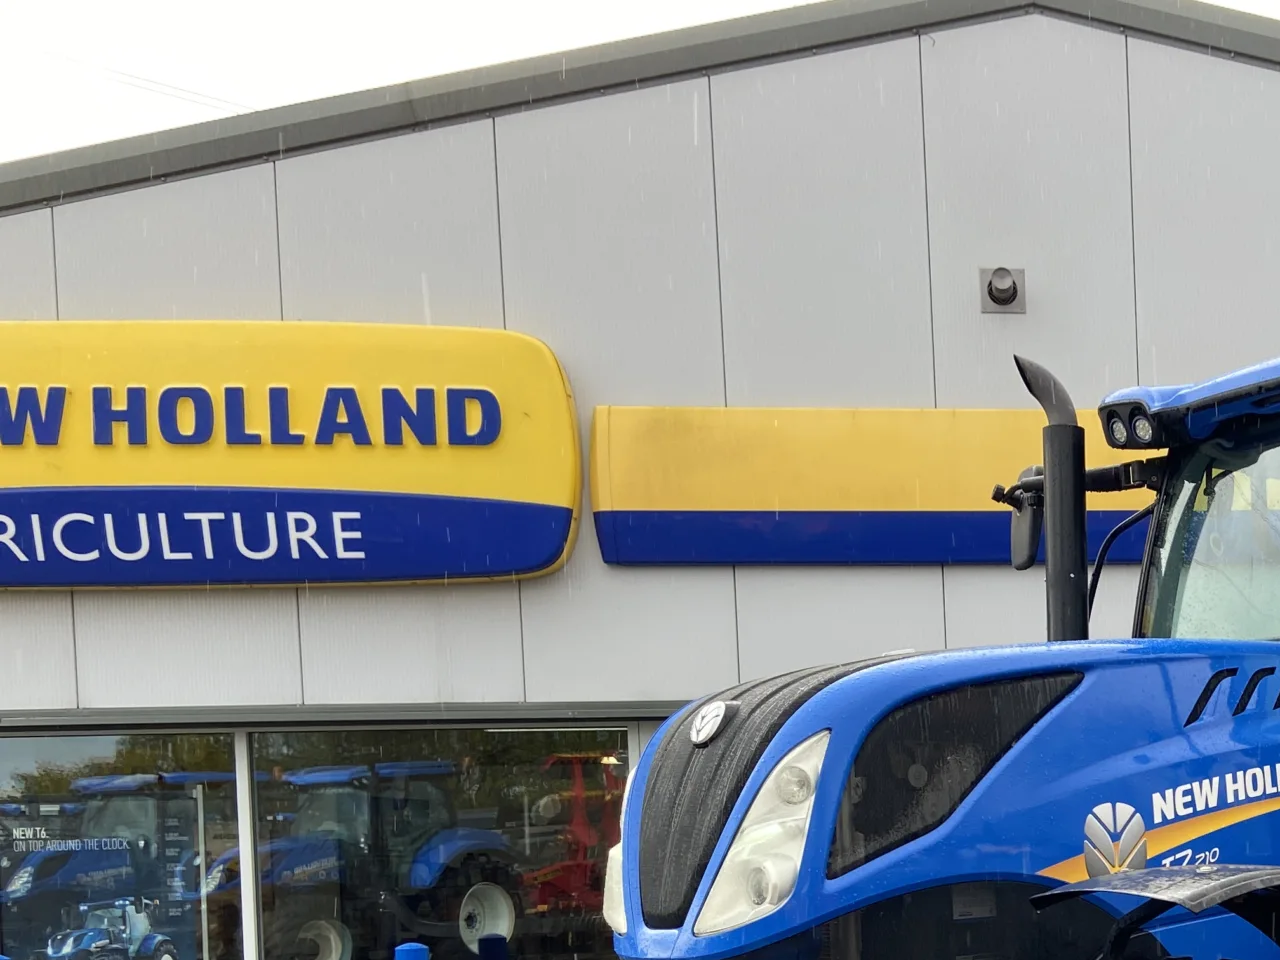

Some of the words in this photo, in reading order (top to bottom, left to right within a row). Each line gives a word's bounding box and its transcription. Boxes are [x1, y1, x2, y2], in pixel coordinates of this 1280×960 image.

[92, 386, 501, 446] HOLLAND
[0, 511, 366, 562] RICULTURE
[1152, 776, 1219, 823] NEW
[12, 828, 33, 839] NEW
[13, 841, 26, 852] ON
[46, 839, 82, 851] AROUND
[84, 839, 99, 850] THE
